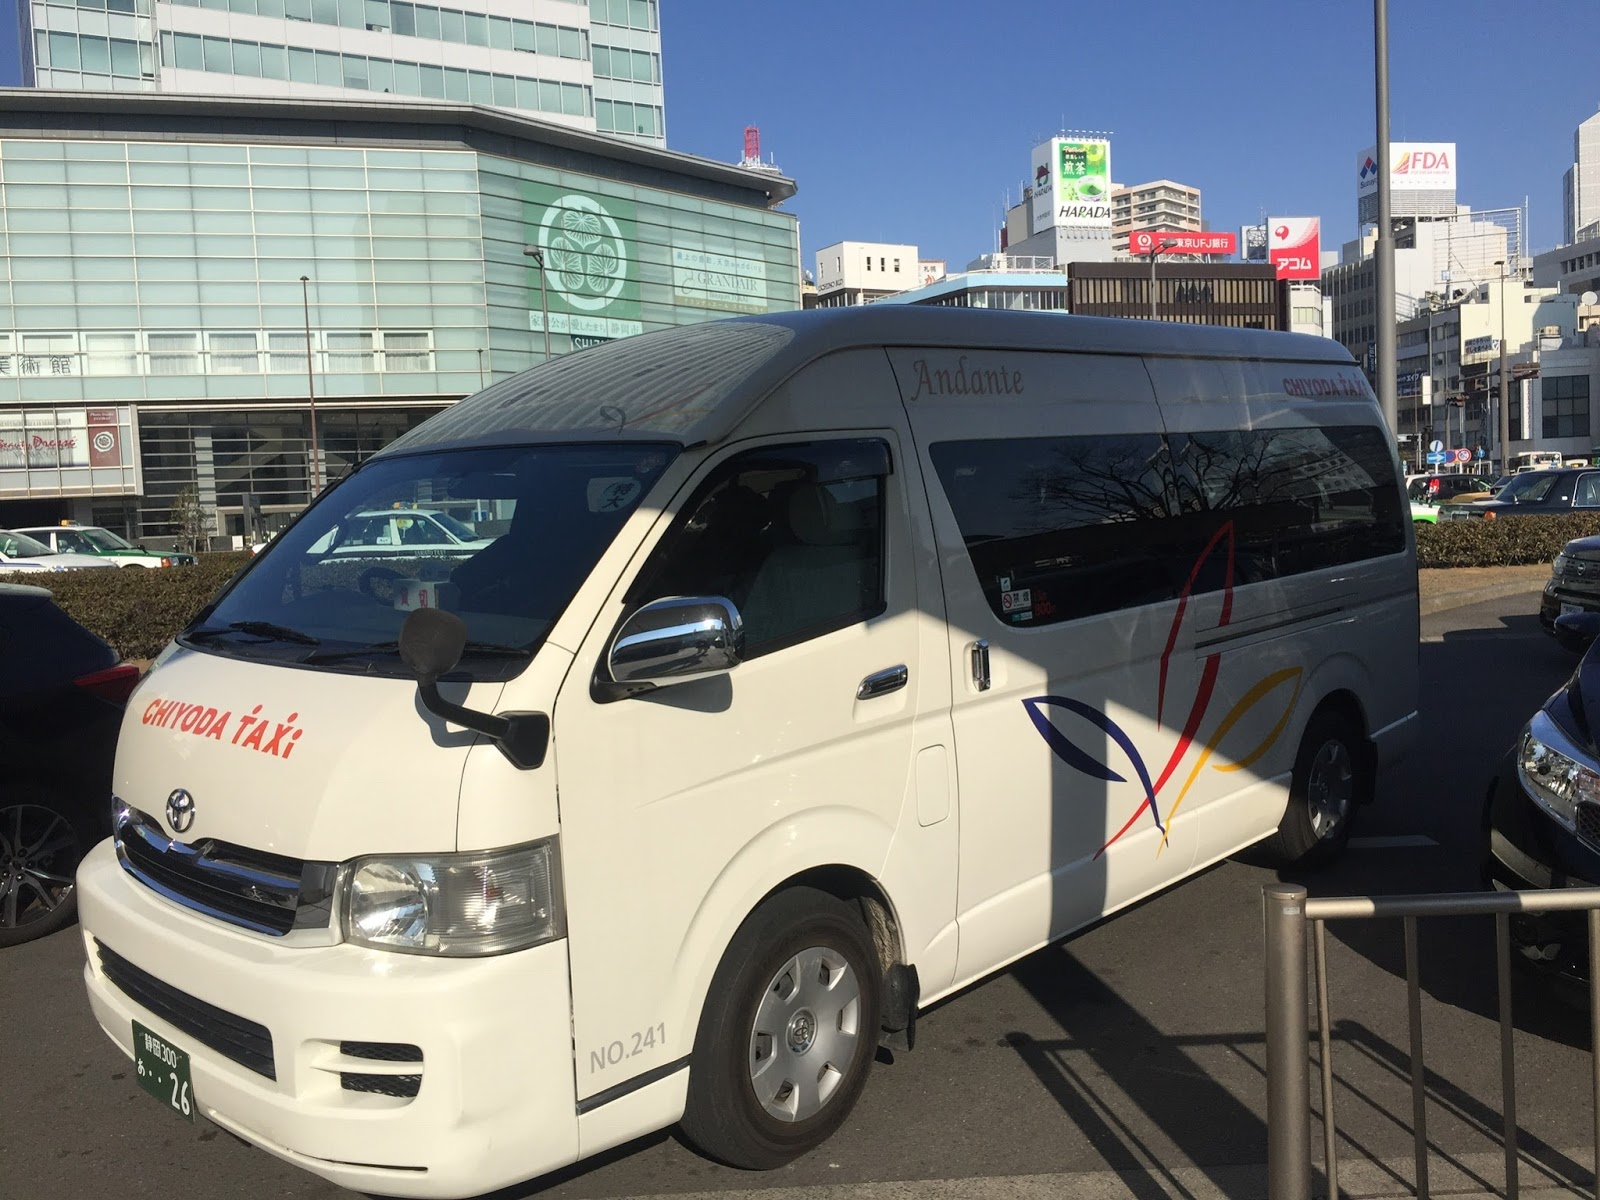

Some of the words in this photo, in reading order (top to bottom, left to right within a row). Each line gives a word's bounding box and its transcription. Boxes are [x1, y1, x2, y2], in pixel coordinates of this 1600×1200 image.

[1064, 161, 1086, 175] 煎茶
[1411, 152, 1449, 169] FDA
[1059, 206, 1111, 218] HARADA
[1158, 238, 1229, 248] 三東京UFJ銀行
[1277, 257, 1312, 270] アコム
[911, 356, 1024, 401] Andante
[1283, 378, 1340, 396] CHIYODA
[142, 698, 232, 740] CHIYODA
[590, 1022, 666, 1073] NO.241
